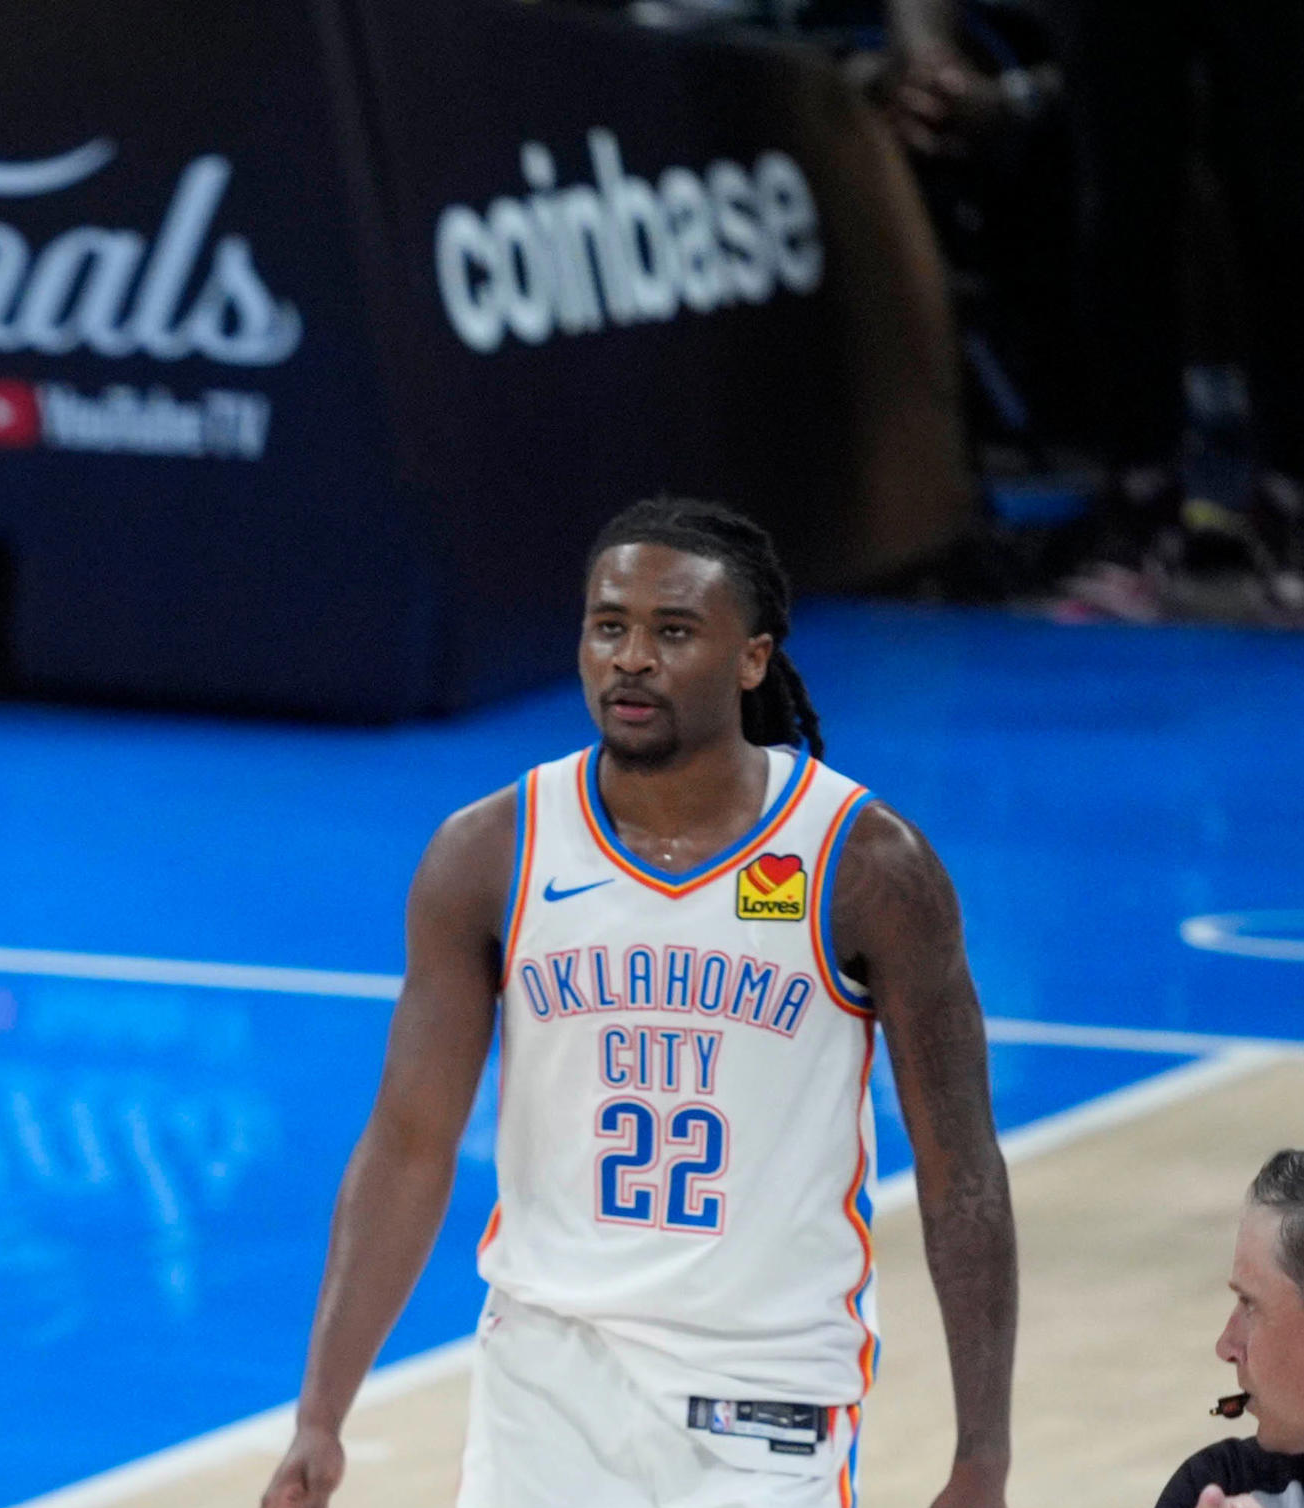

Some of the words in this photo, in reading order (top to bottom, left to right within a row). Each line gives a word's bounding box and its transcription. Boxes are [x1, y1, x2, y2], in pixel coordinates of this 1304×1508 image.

[436, 127, 824, 354] coinbase
[520, 944, 816, 1038] OKLAHOMA
[600, 1025, 722, 1095] CITY
[595, 1096, 729, 1235] 22
